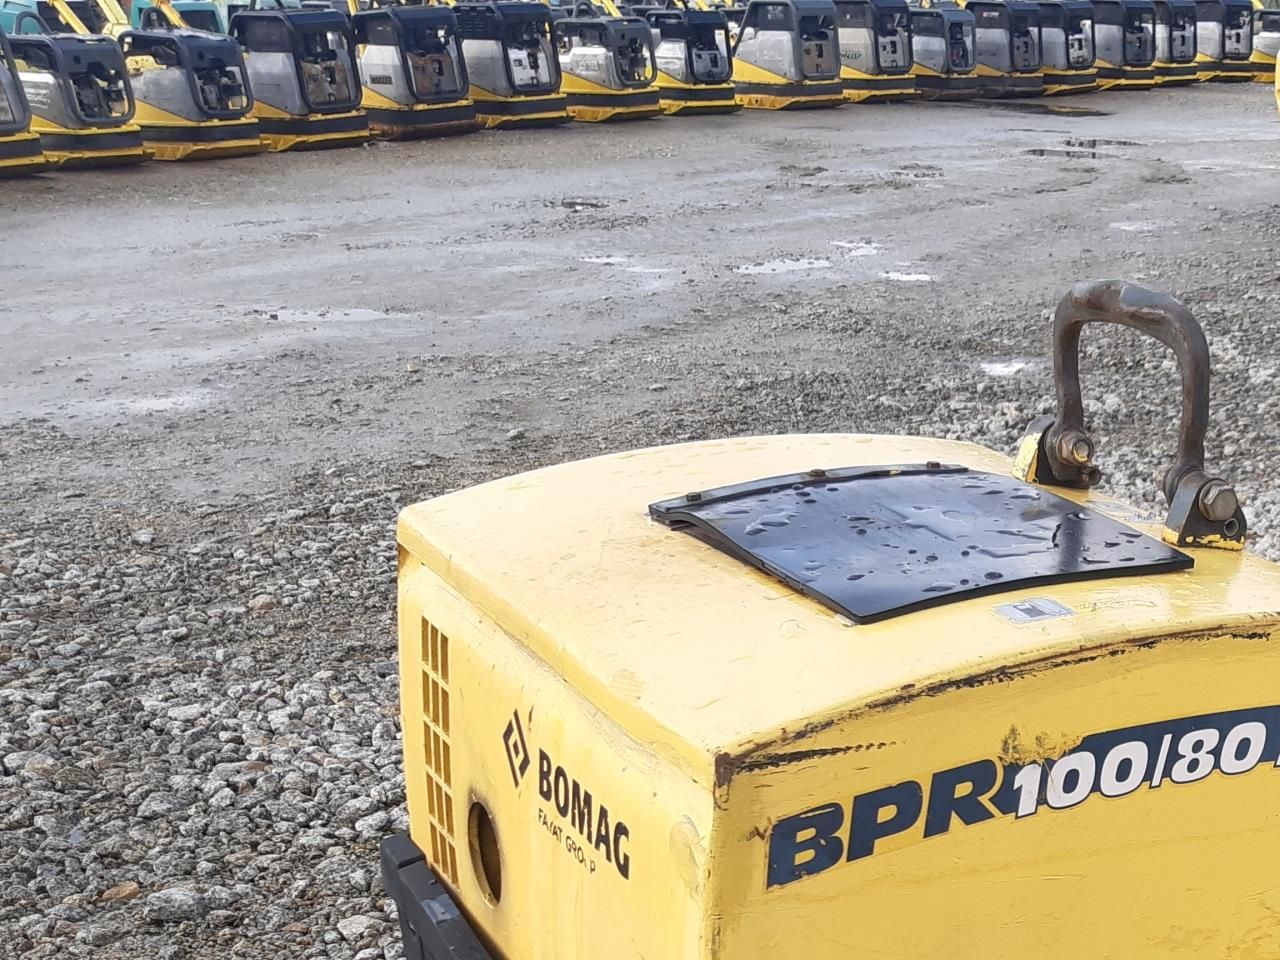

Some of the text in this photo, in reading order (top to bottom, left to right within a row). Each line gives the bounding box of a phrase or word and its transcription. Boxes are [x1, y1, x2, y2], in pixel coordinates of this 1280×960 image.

[538, 747, 631, 880] BOMAG
[766, 758, 1004, 890] BPR
[1012, 721, 1268, 818] 100/80
